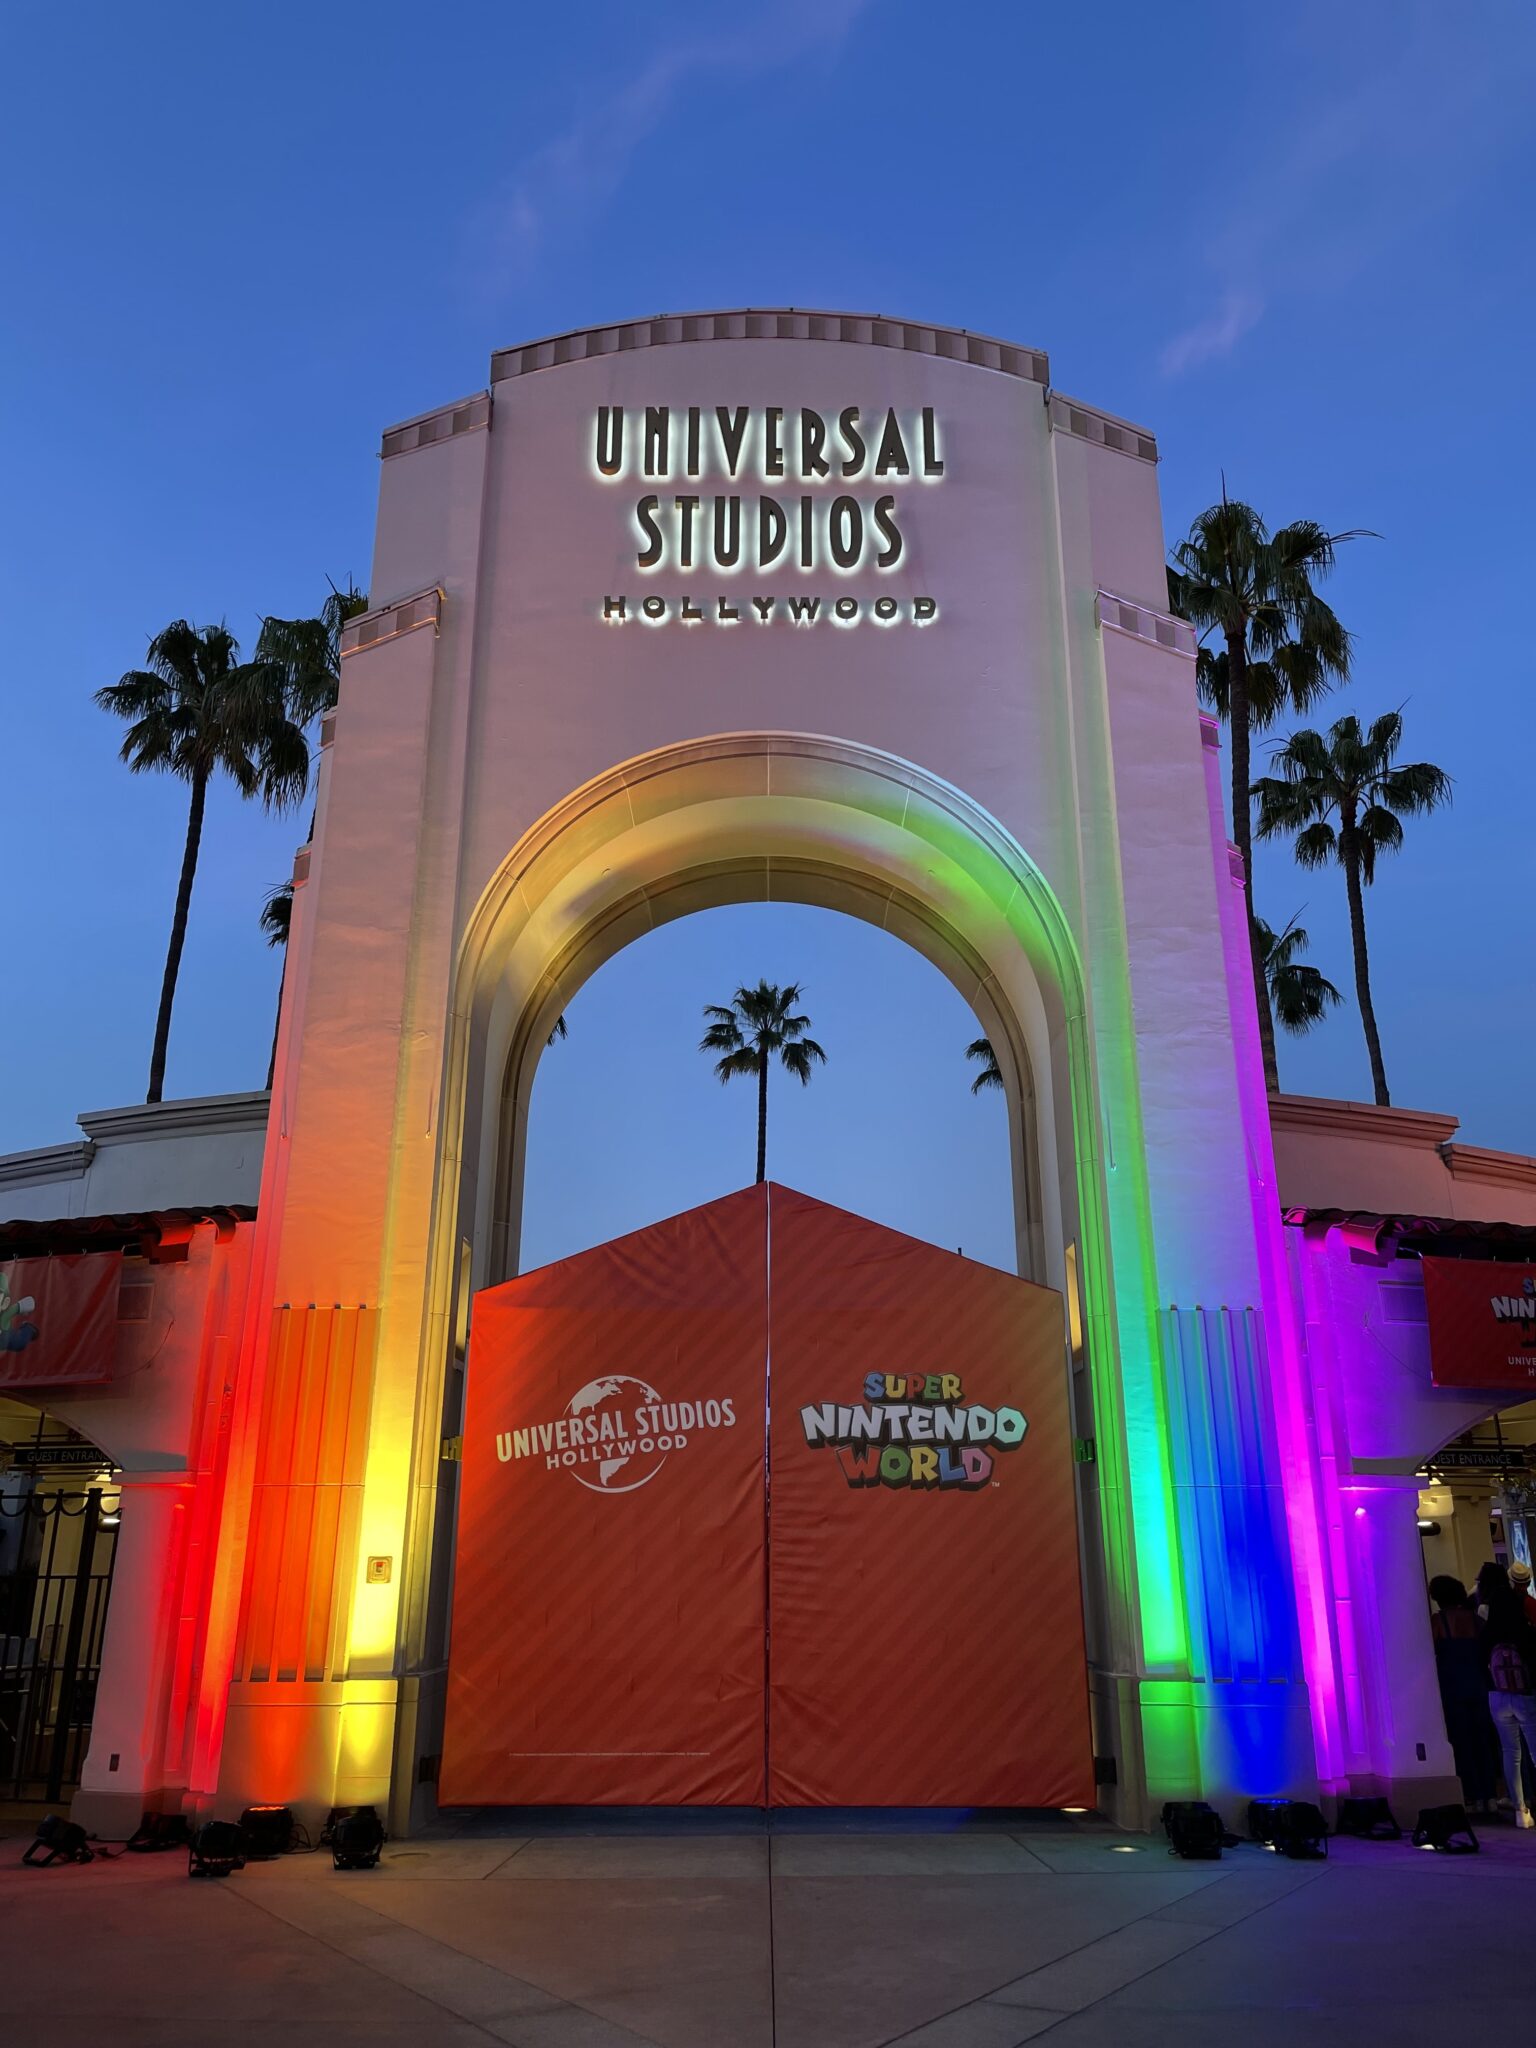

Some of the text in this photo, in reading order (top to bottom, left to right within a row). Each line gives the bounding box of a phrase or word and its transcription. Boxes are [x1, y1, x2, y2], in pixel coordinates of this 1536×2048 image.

[596, 406, 944, 477] UNIVERSAL
[636, 495, 902, 567] STUDIOS
[603, 595, 937, 620] HOLLYWOOD
[864, 1372, 965, 1400] SUPER
[496, 1398, 736, 1462] UNIVERSAL STUDIOS
[800, 1402, 1028, 1446] NINTENDO
[27, 1451, 58, 1462] GUEST
[546, 1434, 687, 1470] HOLLYWOOD
[836, 1444, 994, 1490] WORLD
[1459, 1453, 1511, 1464] ENTRANCE
